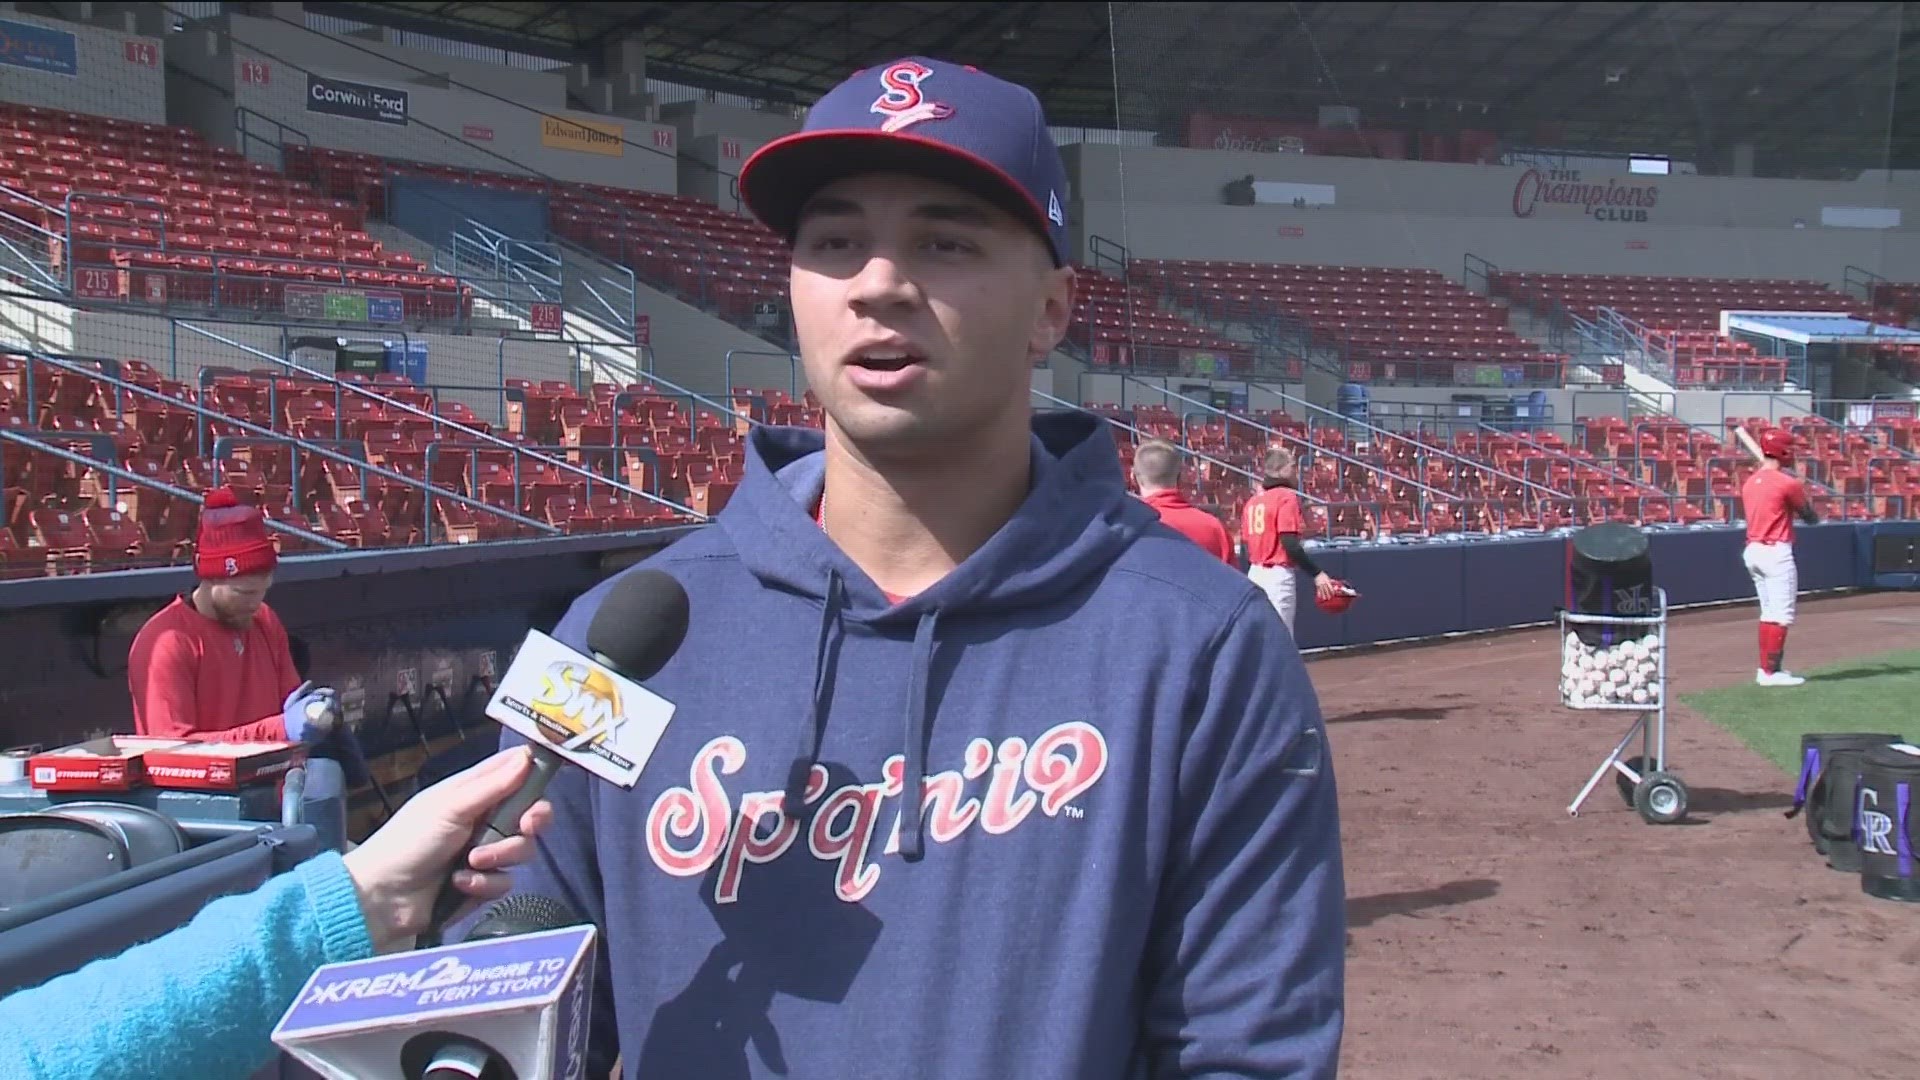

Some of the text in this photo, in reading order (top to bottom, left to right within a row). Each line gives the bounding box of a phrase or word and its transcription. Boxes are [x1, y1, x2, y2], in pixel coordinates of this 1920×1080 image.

[133, 44, 149, 64] 14
[248, 65, 263, 83] 13
[312, 84, 404, 112] Corwin Ford
[544, 120, 620, 145] Edward Jones
[658, 131, 669, 147] 12
[1550, 169, 1581, 182] THE
[1513, 168, 1658, 218] Champions
[1594, 207, 1648, 222] CLUB
[86, 271, 109, 290] 215
[538, 304, 554, 323] 215
[1248, 503, 1265, 535] 18
[466, 960, 535, 983] MORE
[537, 957, 566, 974] TO
[416, 973, 558, 1006] EVERY STORY
